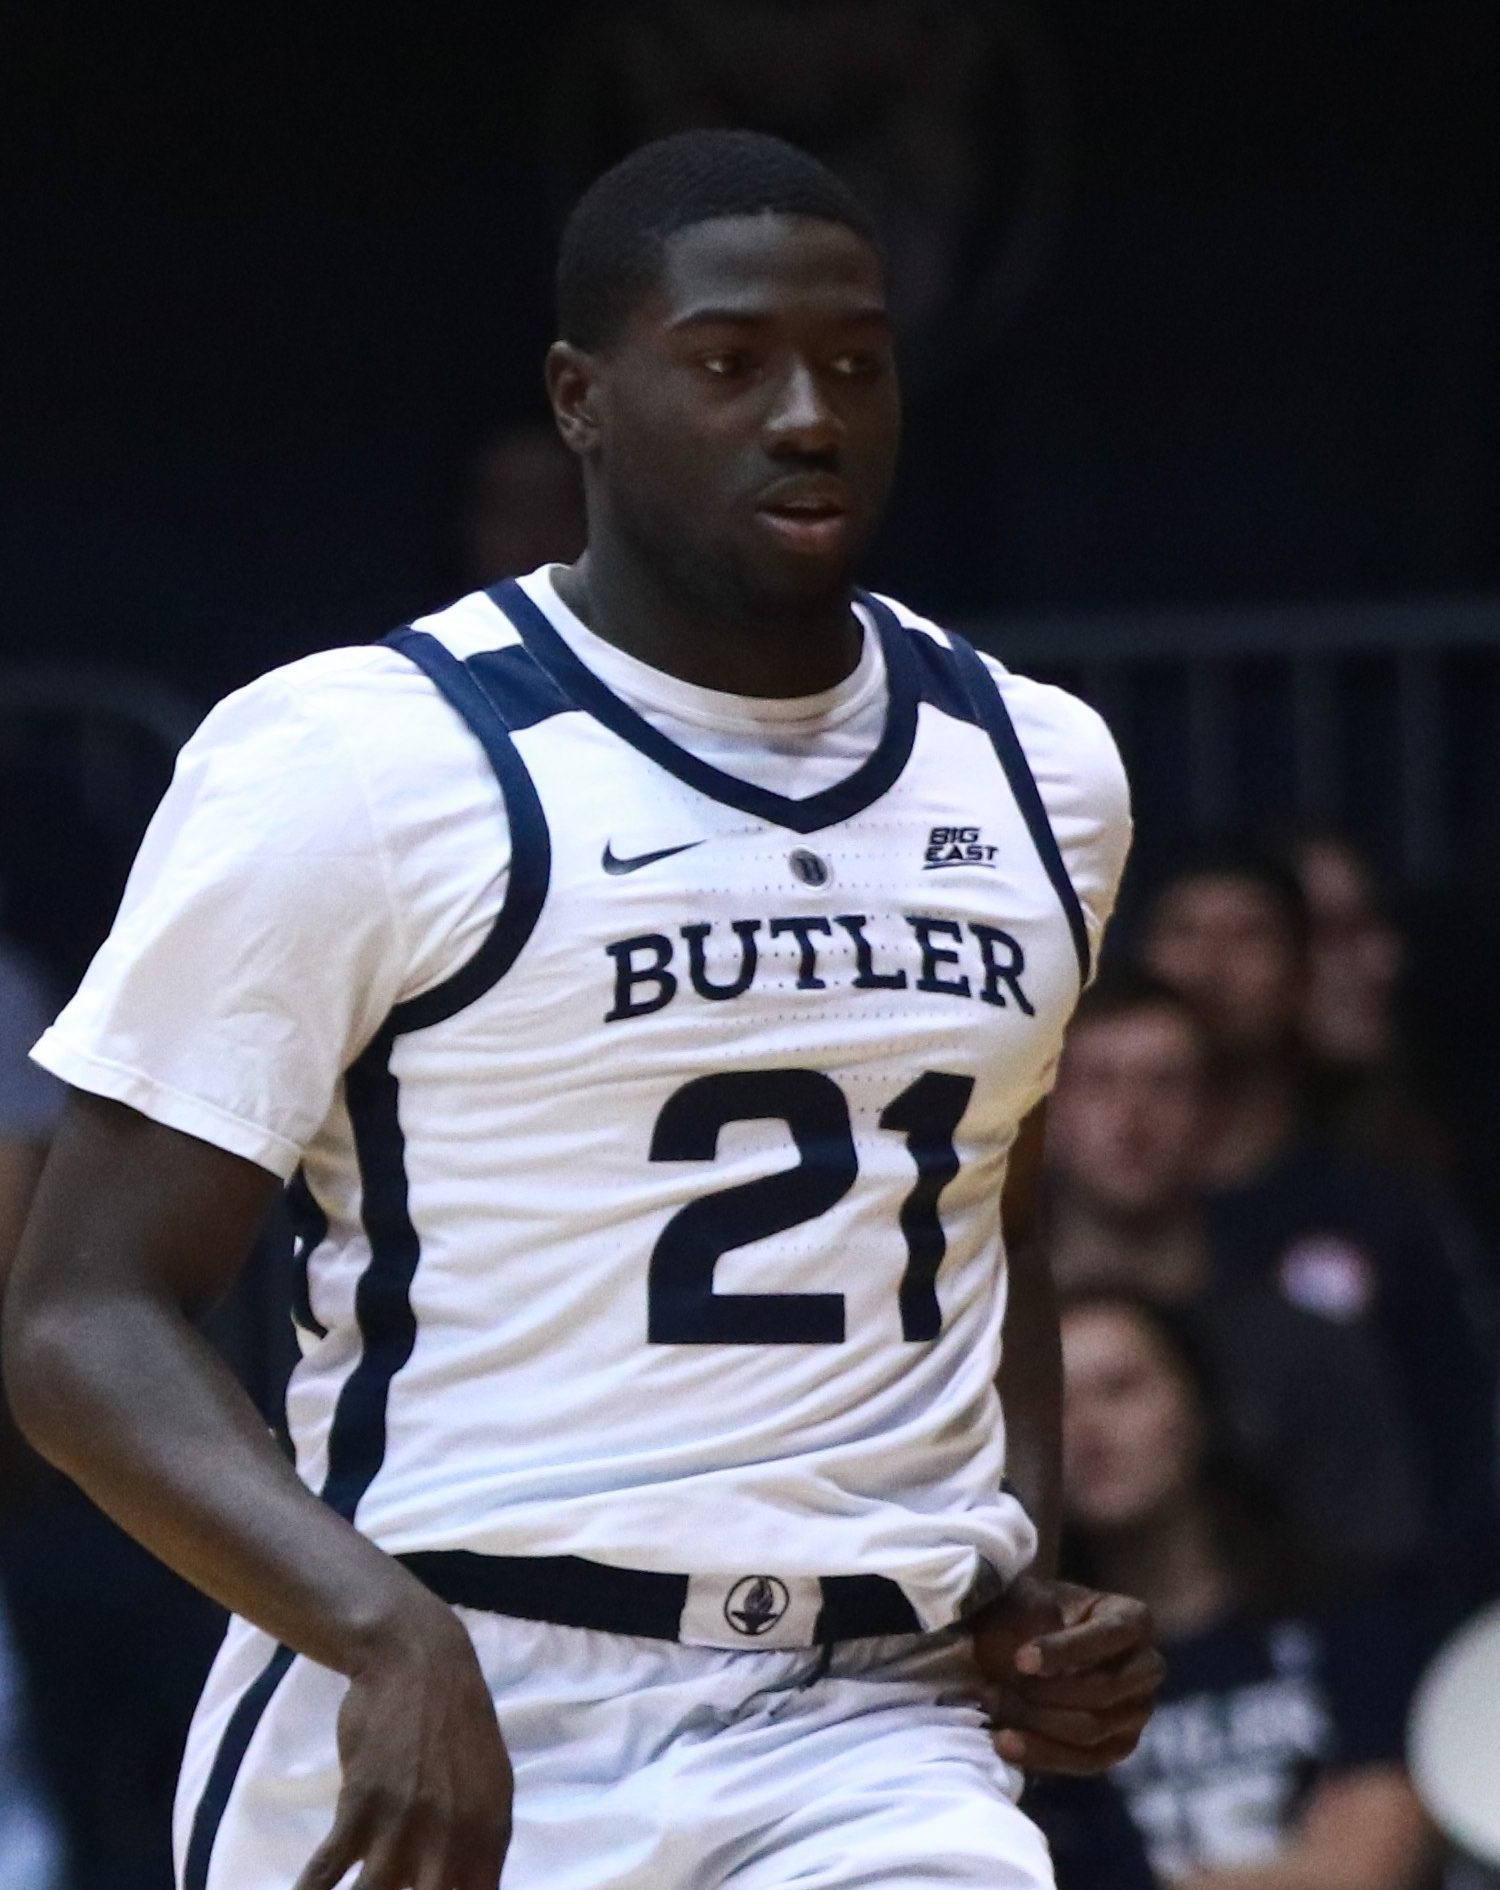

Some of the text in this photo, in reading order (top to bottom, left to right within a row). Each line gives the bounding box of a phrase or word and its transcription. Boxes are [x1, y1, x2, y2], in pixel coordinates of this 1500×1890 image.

[925, 846, 999, 862] EAST
[929, 827, 980, 845] BIG
[604, 915, 1035, 1023] BUTLER
[647, 1067, 975, 1344] 21
